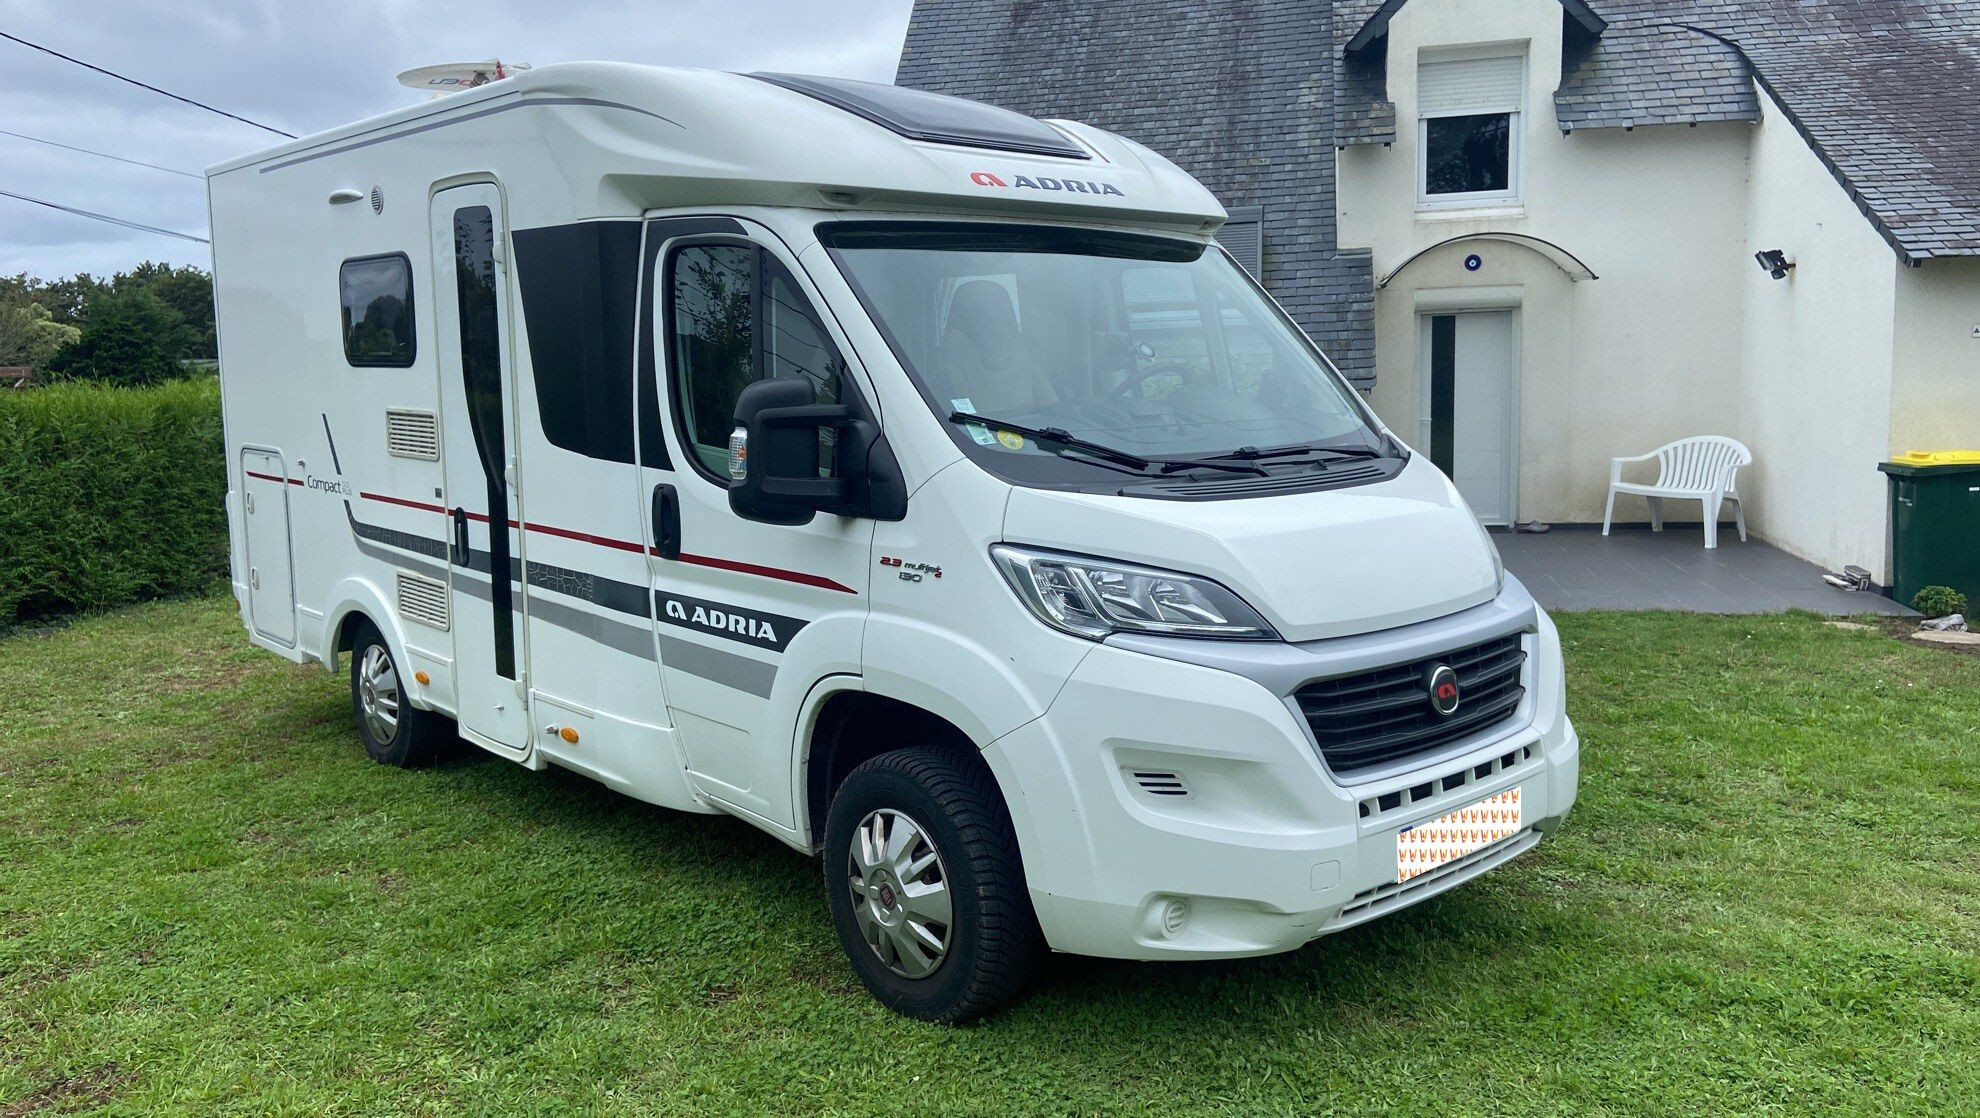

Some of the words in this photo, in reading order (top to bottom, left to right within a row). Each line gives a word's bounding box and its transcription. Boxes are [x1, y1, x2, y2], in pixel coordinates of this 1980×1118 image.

[1014, 174, 1126, 197] ADRIA
[307, 475, 342, 494] Compact
[899, 571, 923, 583] 130
[691, 606, 778, 643] ADRIA
